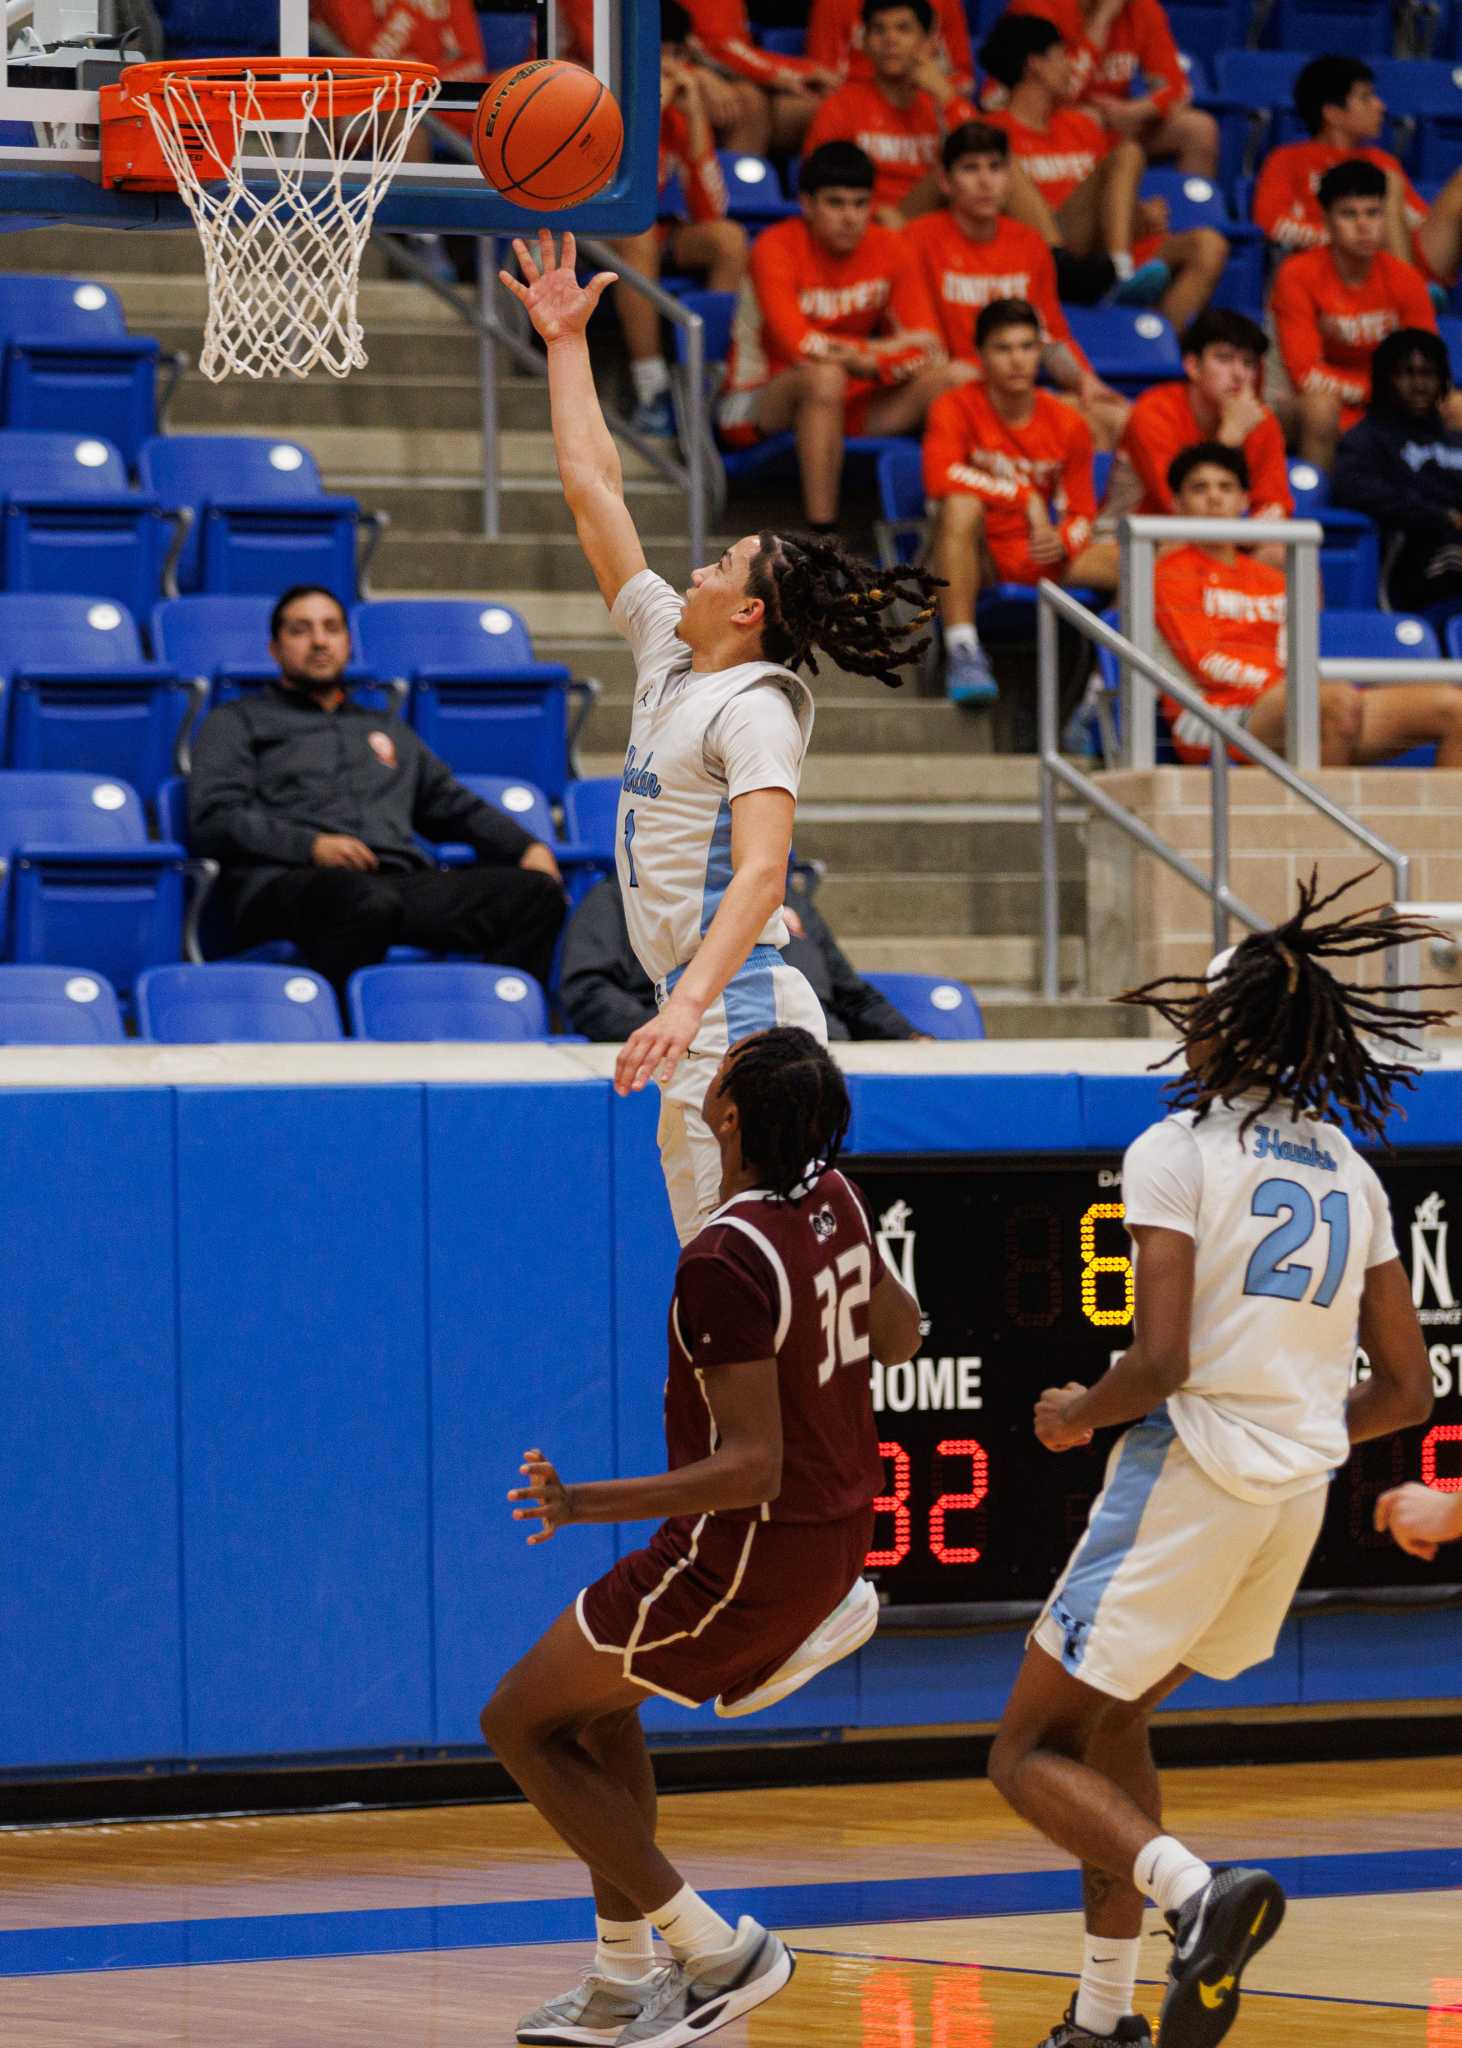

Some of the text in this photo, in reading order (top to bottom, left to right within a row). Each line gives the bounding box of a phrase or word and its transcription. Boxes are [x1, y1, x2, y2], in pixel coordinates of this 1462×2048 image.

[624, 808, 639, 888] 1
[1242, 1177, 1350, 1309] 21
[813, 1241, 872, 1388] 32
[863, 1439, 989, 1567] 32
